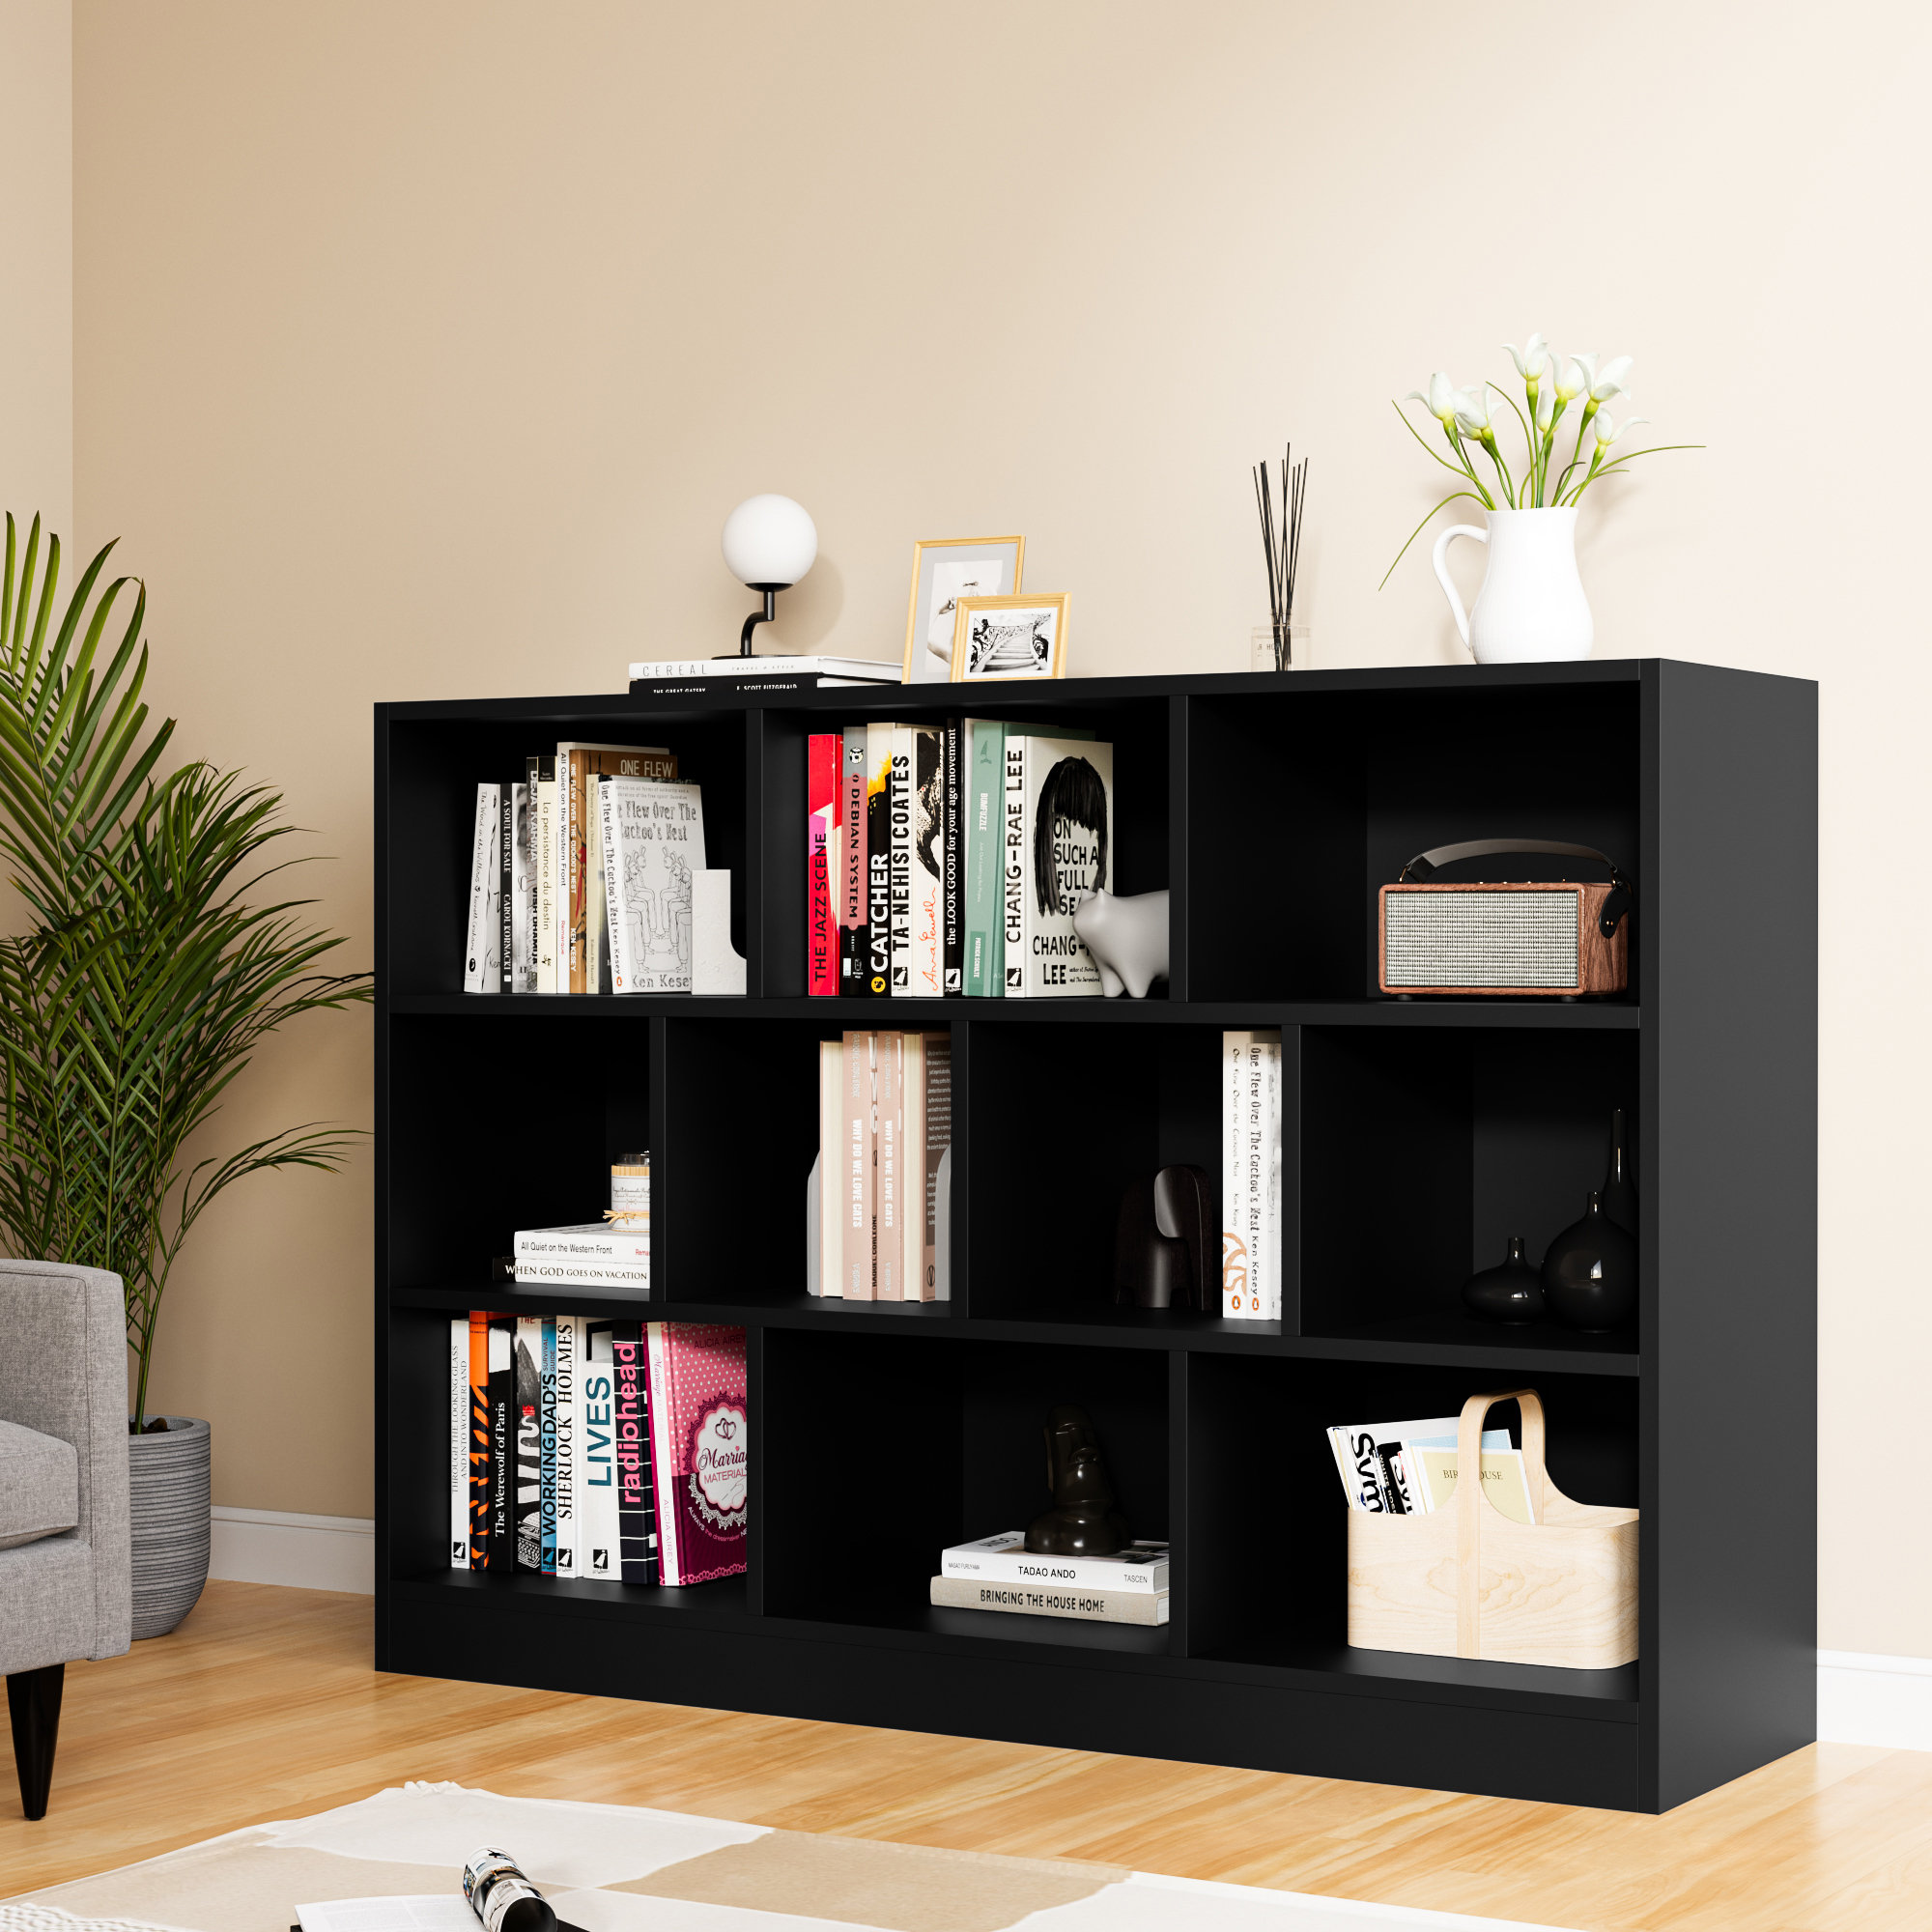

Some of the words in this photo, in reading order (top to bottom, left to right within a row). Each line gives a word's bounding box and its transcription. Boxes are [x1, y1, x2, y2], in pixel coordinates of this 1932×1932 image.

[642, 664, 707, 676] CEREAL
[947, 727, 957, 785] movement
[620, 759, 639, 776] ONE
[644, 760, 672, 778] FLEW
[1006, 750, 1023, 791] LEE
[529, 770, 538, 806] DEJA
[560, 793, 566, 805] on
[601, 784, 611, 800] One
[947, 788, 958, 807] age
[543, 802, 552, 813] La
[603, 803, 611, 823] Flew
[625, 800, 649, 819] Flew
[653, 801, 675, 820] Over
[678, 802, 696, 821] The
[850, 788, 861, 849] DEBIAN
[979, 792, 989, 831] BUMFUZZLE
[666, 822, 688, 841] Nest
[947, 809, 958, 834] your
[1053, 817, 1071, 839] ON
[605, 826, 613, 845] Over
[946, 834, 956, 849] for
[541, 818, 552, 877] persistance
[607, 848, 615, 864] The
[1053, 842, 1087, 866] SUCH
[1089, 845, 1099, 866] A
[814, 833, 827, 891] SCENE
[947, 851, 956, 890] GOOD
[1006, 803, 1023, 944] CHANG-RAE
[543, 881, 553, 895] du
[849, 854, 860, 918] SYSTEM
[1057, 869, 1089, 891] FULL
[503, 894, 512, 923] CAROL
[543, 899, 553, 929] destin
[611, 907, 619, 925] Nest
[870, 853, 889, 973] CATCHER
[947, 891, 956, 924] LOOK
[1059, 894, 1081, 917] SE
[814, 896, 827, 941] JAZZ
[947, 924, 956, 946] the
[1032, 934, 1090, 956] CHANG-
[503, 925, 512, 970] KORNACKI
[814, 948, 827, 982] THE
[1042, 963, 1066, 984] LEE
[1250, 1047, 1262, 1067] One
[1250, 1071, 1262, 1097] Flew
[1250, 1101, 1262, 1124] Over
[852, 1119, 863, 1142] WHY
[1250, 1130, 1262, 1151] The
[852, 1144, 863, 1157] DO
[885, 1144, 893, 1157] DO
[852, 1159, 863, 1176] WE
[885, 1159, 893, 1176] WE
[1250, 1153, 1261, 1203] Cuckoo's
[852, 1178, 863, 1201] LOVE
[852, 1203, 863, 1228] CATS
[1250, 1208, 1261, 1232] Nest
[521, 1241, 529, 1251] All
[530, 1242, 548, 1252] Quiet
[557, 1243, 568, 1253] the
[570, 1243, 594, 1254] Western
[596, 1244, 612, 1255] Front
[1251, 1236, 1260, 1256] Ken
[505, 1264, 537, 1276] WHEN
[540, 1266, 564, 1277] GOD
[566, 1268, 588, 1278] GOES
[589, 1269, 603, 1278] ON
[605, 1270, 647, 1280] VACATION
[1250, 1261, 1259, 1295] Kesey
[694, 1338, 721, 1350] ALICIA
[722, 1334, 747, 1346] AIRE
[557, 1323, 573, 1404] HOLMES
[495, 1402, 505, 1433] Paris
[613, 1343, 641, 1503] radiohead
[495, 1433, 505, 1449] of
[585, 1377, 612, 1487] LIVES
[495, 1448, 505, 1508] Werewolf
[557, 1415, 573, 1520] SHERLOCK
[703, 1467, 747, 1485] MATERIAL
[1378, 1453, 1390, 1487] WHITE
[495, 1509, 505, 1537] The
[687, 1506, 706, 1532] ALWAYS
[666, 1534, 674, 1565] AIREY
[1017, 1565, 1048, 1577] TADAO
[1050, 1567, 1076, 1579] ANDO
[980, 1588, 1023, 1605] BRINGING
[1026, 1593, 1044, 1607] THE
[1046, 1595, 1076, 1611] HOUSE
[1079, 1598, 1105, 1613] HOME
